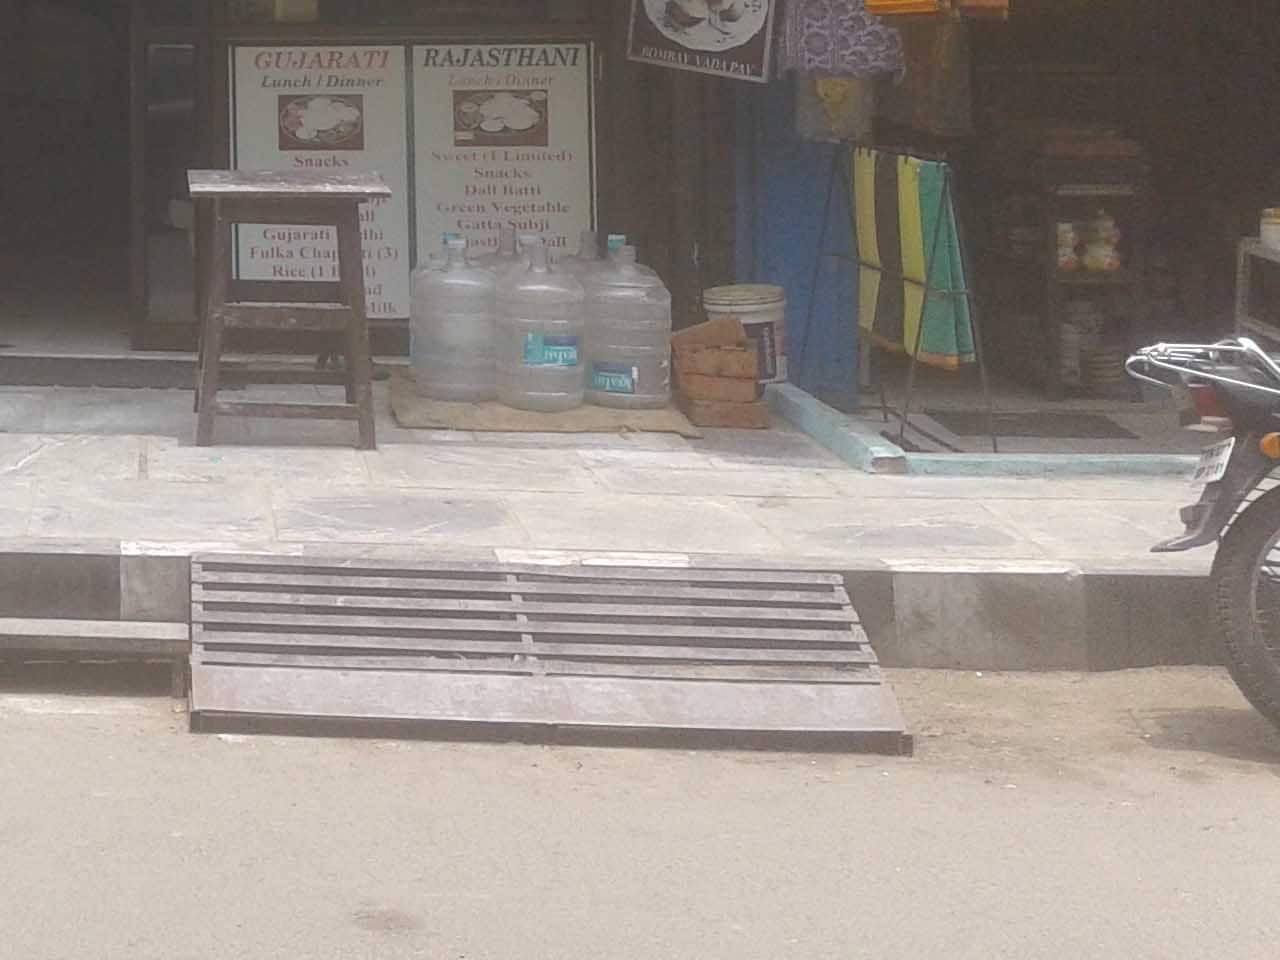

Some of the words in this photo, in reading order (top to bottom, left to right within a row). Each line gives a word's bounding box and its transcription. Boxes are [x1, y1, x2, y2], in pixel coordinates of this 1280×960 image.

[254, 50, 390, 70] GUJARATI
[424, 47, 581, 67] RAJASTHANI
[261, 75, 312, 88] Lunch
[326, 74, 384, 88] Dinner
[293, 155, 350, 168] Snacks
[263, 229, 331, 243] Gujarati
[250, 246, 294, 259] Fulka
[272, 265, 305, 278] Rice
